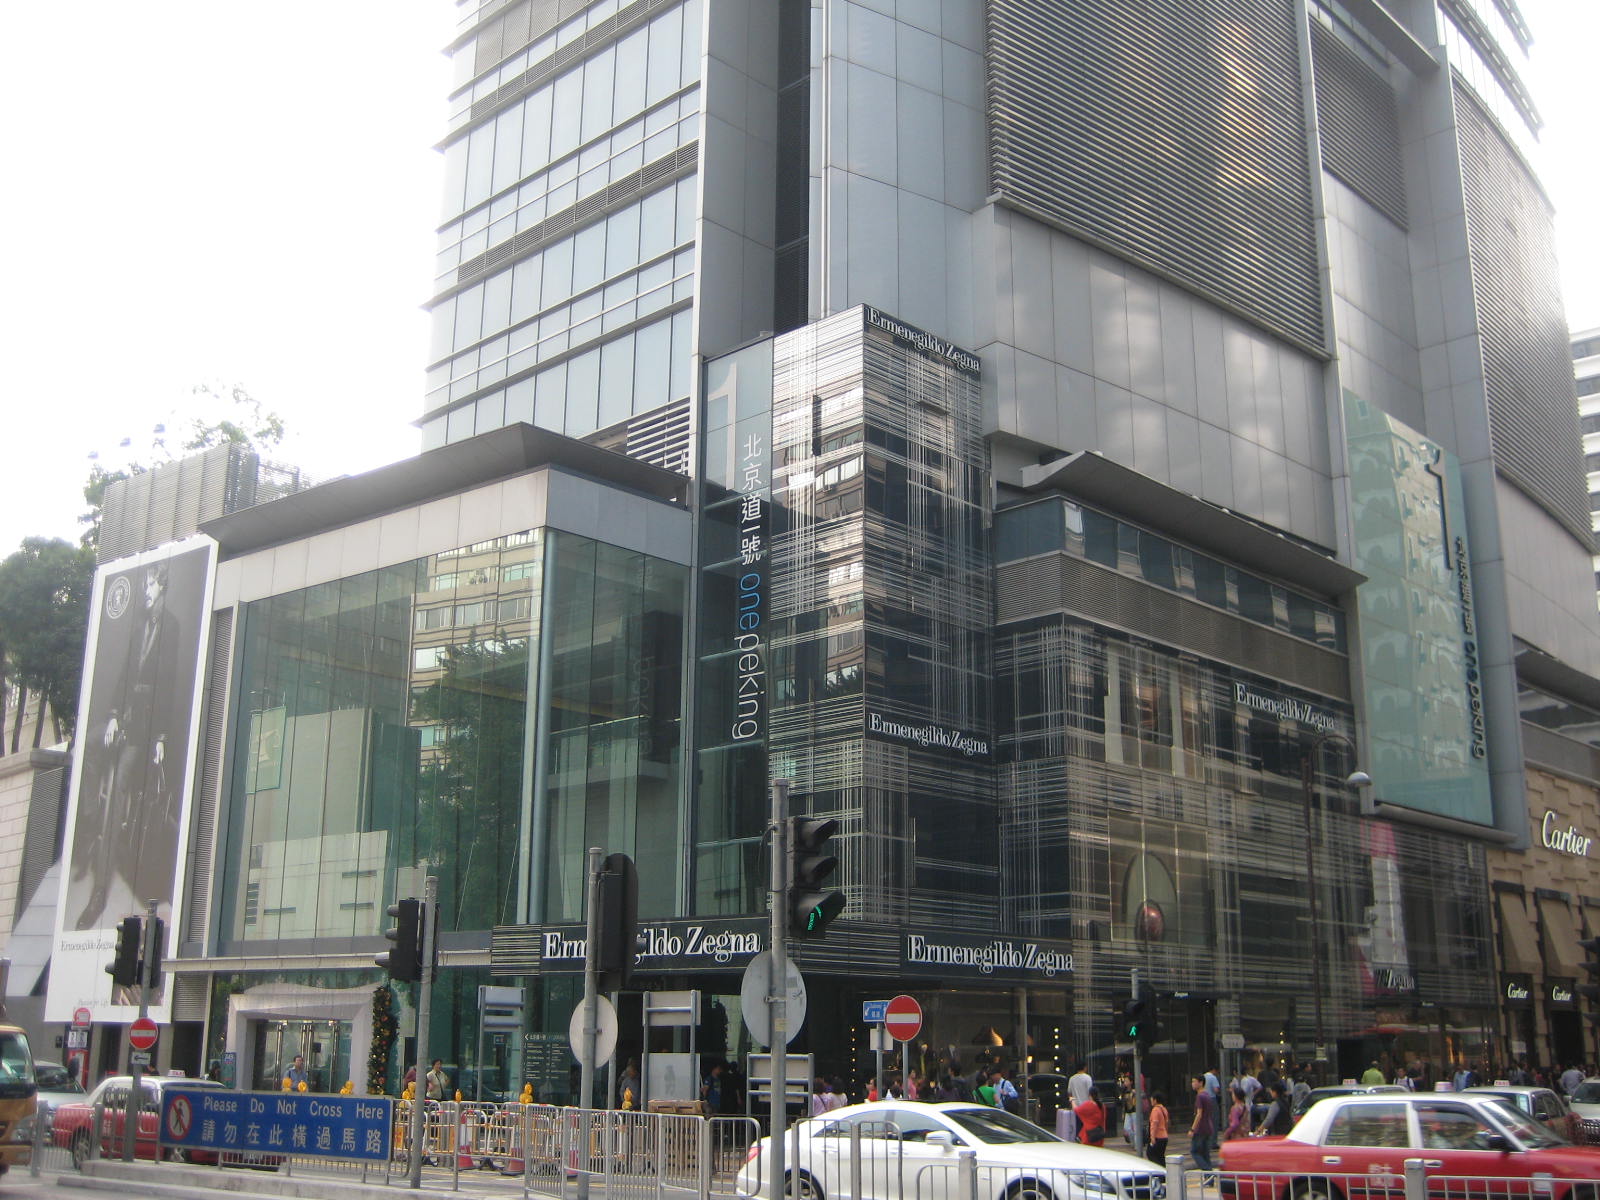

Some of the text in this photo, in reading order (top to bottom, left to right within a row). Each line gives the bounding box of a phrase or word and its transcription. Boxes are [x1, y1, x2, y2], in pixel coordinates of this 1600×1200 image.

[867, 307, 980, 371] Ermenegildo Zegna
[707, 362, 737, 491] 1
[741, 433, 762, 565] 北京道一號
[1234, 682, 1335, 733] Ermenegildo Zegna
[869, 712, 988, 755] Ermenegildo Zegna
[1542, 810, 1591, 856] Cartier
[542, 926, 762, 965] Ermildo Zegna
[907, 934, 1073, 977] Ermenegildo Zegna
[1507, 982, 1528, 999] Cartier
[1552, 985, 1572, 1001] Cartier
[203, 1096, 384, 1120] Please Do Not Cross Here
